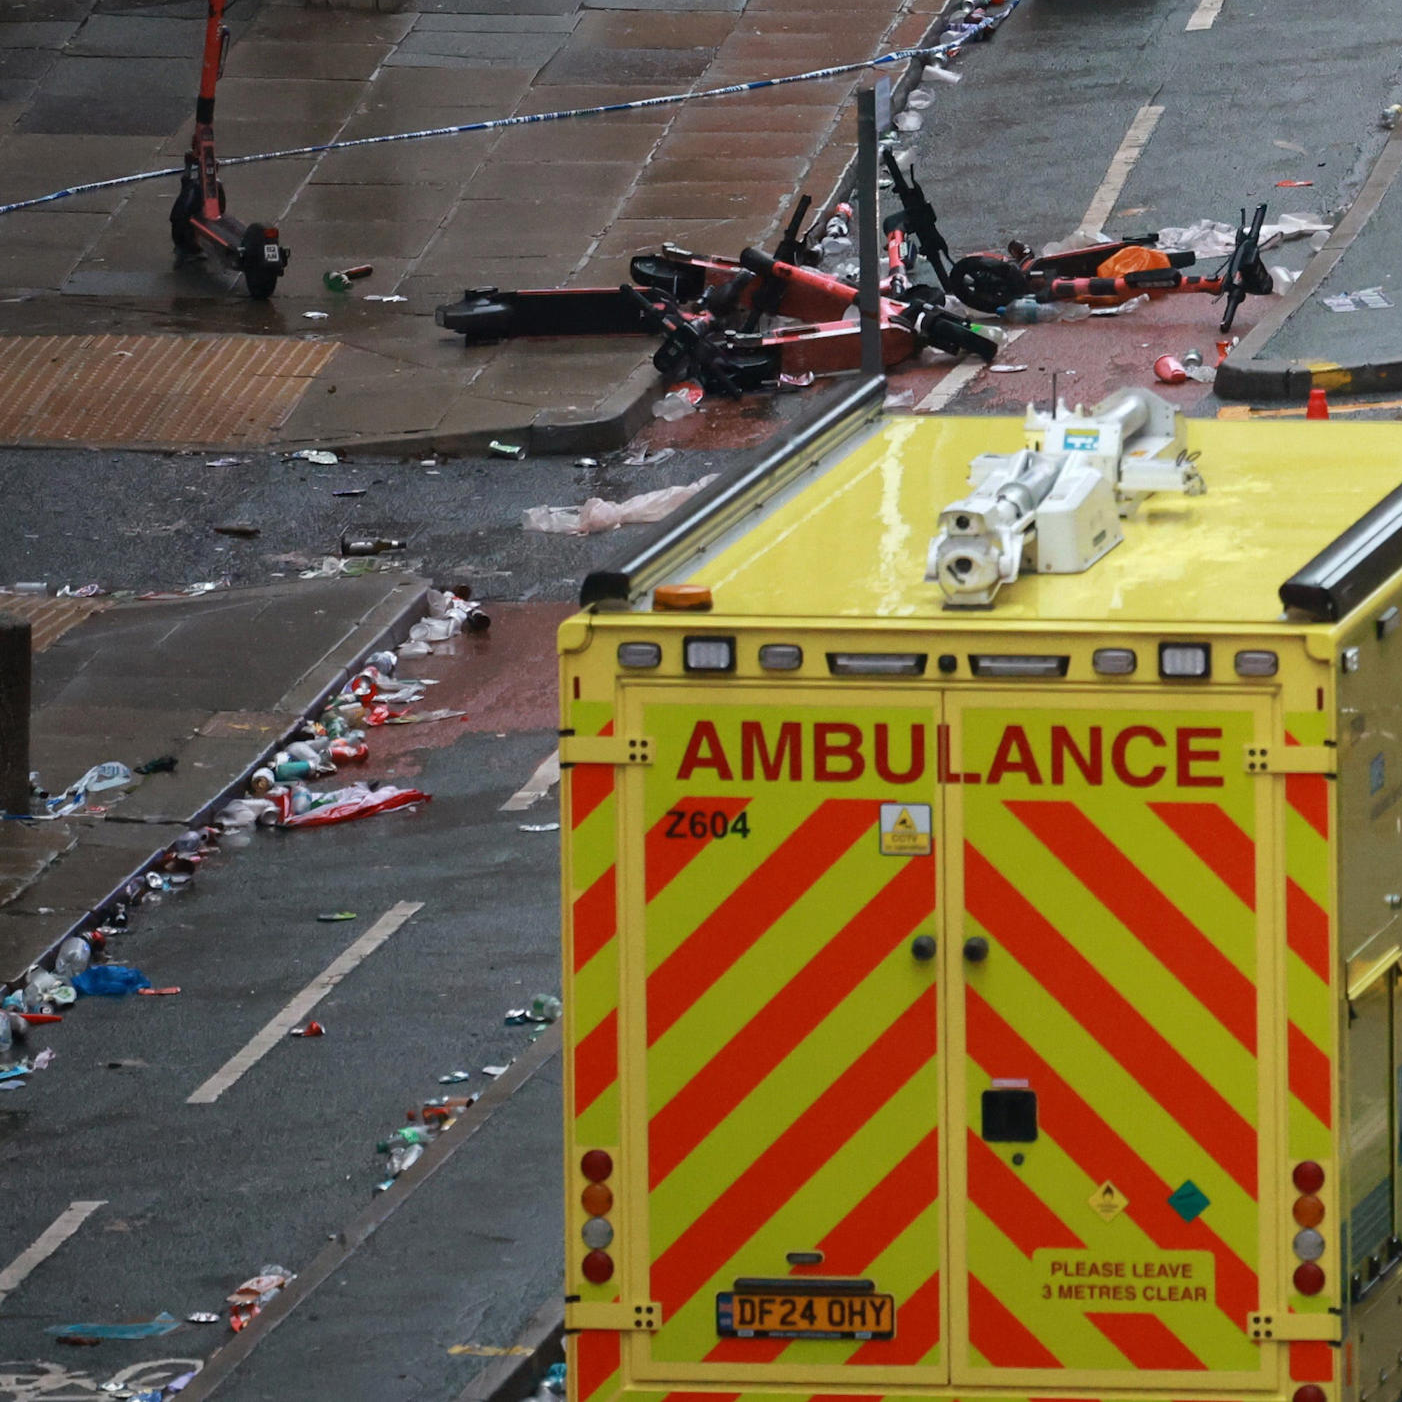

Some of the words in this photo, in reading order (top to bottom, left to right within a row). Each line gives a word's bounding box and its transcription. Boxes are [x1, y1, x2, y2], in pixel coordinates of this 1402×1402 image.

[676, 720, 1225, 788] AMBULANCE
[665, 808, 751, 840] Z604
[1050, 1262, 1126, 1278] PLEASE
[1132, 1263, 1193, 1279] LEAVE
[1042, 1285, 1052, 1300] 3
[1058, 1285, 1137, 1301] METRES
[1142, 1286, 1207, 1302] CLEAR
[738, 1299, 817, 1326] DF24
[827, 1299, 887, 1327] OHY
